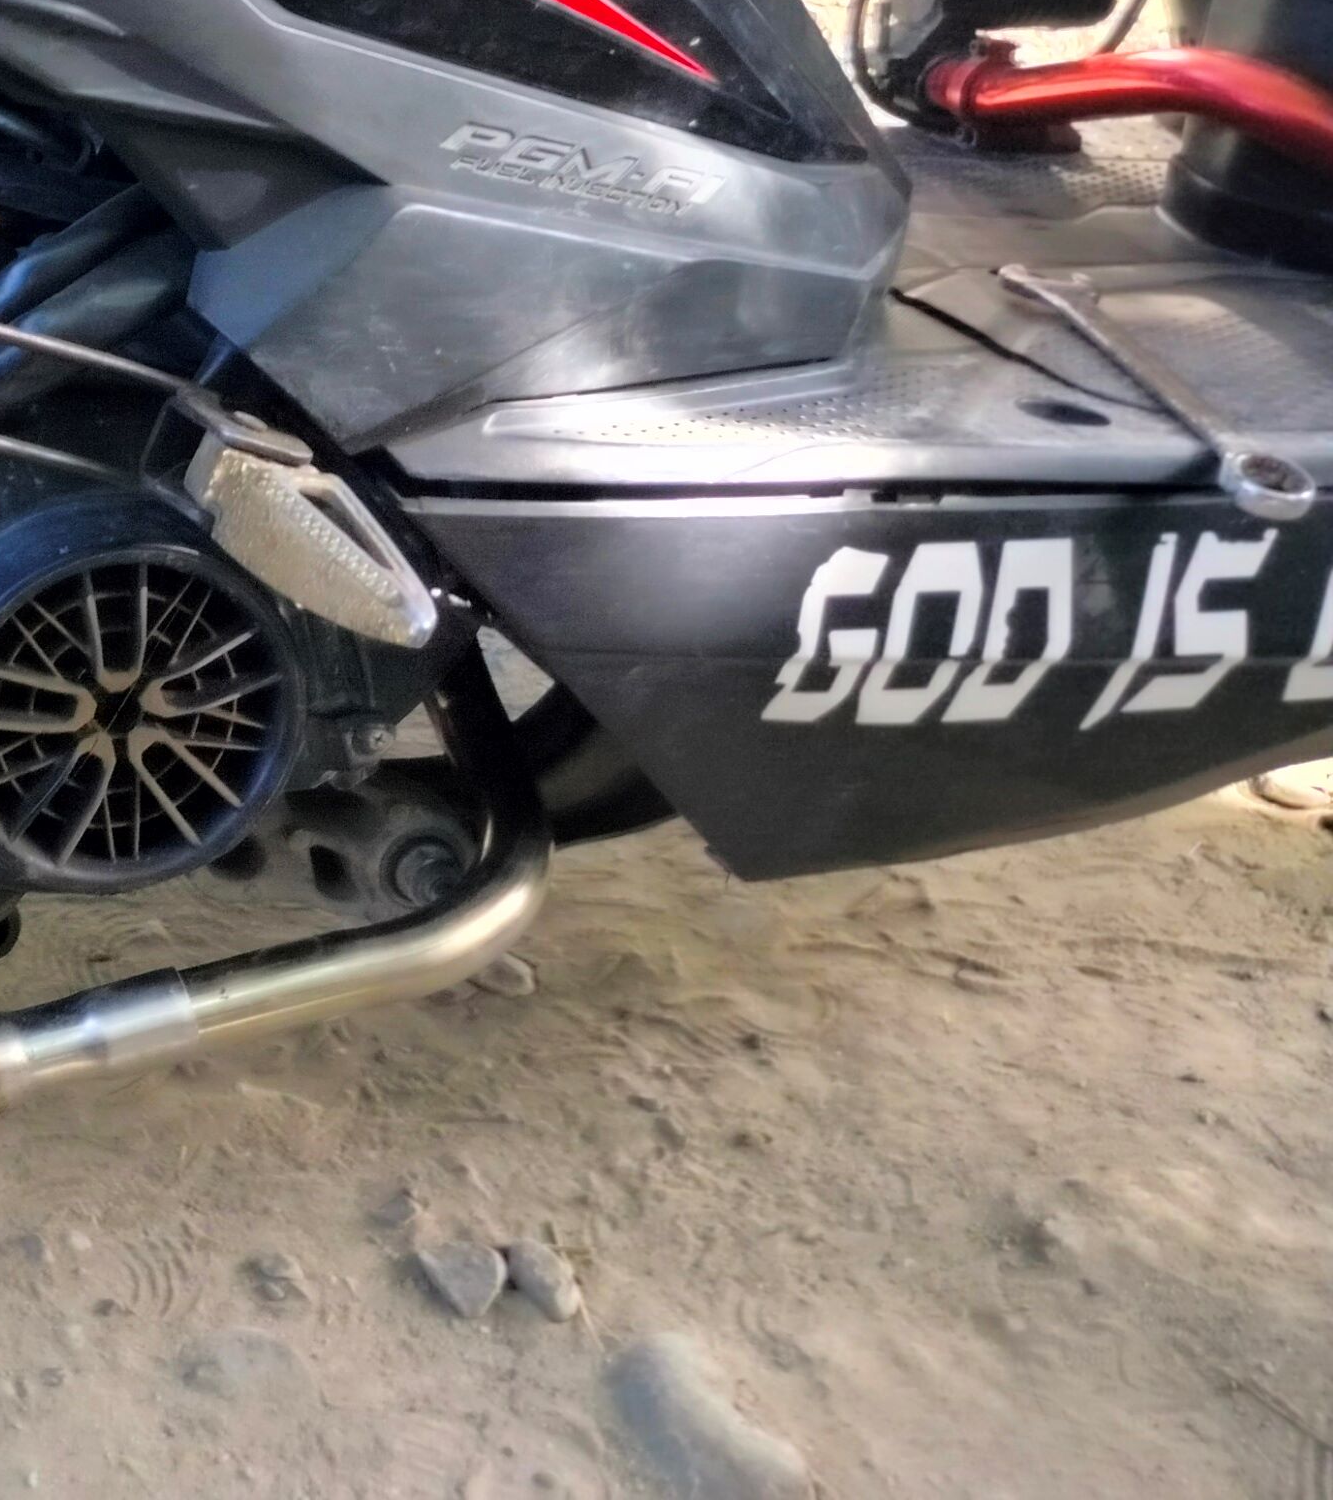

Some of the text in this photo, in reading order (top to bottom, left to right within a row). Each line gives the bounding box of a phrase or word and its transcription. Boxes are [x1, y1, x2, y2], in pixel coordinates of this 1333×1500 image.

[439, 121, 727, 204] PGM-FI
[449, 155, 692, 218] FUEL INJECTION
[761, 537, 1074, 725] GOD
[1078, 527, 1279, 732] IS
